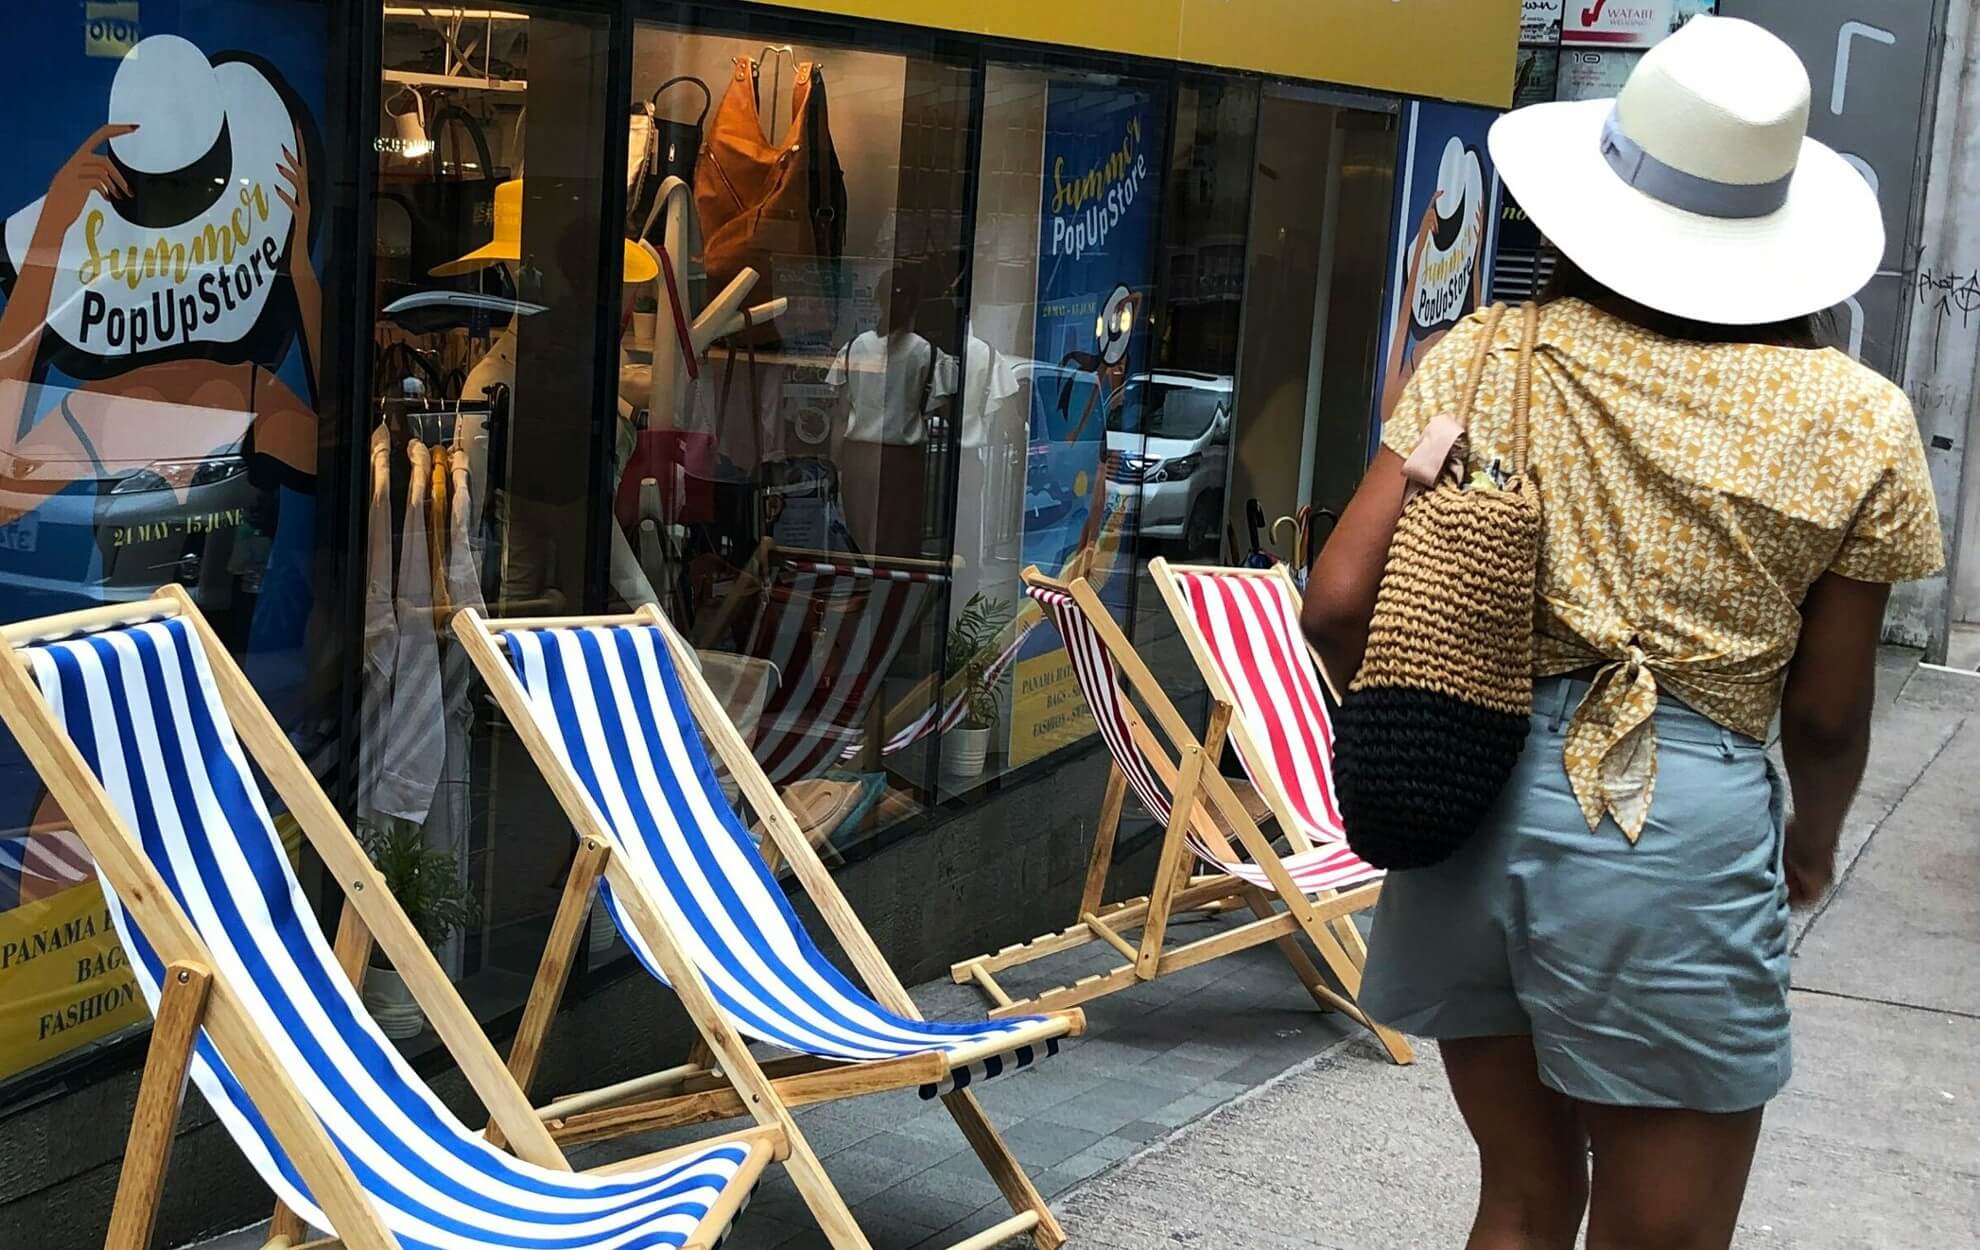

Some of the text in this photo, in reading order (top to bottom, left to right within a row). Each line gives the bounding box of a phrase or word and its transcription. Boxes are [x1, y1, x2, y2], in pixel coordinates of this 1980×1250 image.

[1051, 113, 1141, 214] Summer
[79, 182, 270, 290] Summer
[1052, 153, 1147, 261] PopUpStore
[79, 236, 282, 354] PopUpStore
[1418, 256, 1472, 325] PopUpStore
[137, 521, 170, 544] MAY
[205, 508, 244, 533] JUNE
[1, 914, 96, 969] PANAMA
[38, 979, 136, 1041] FASHION
